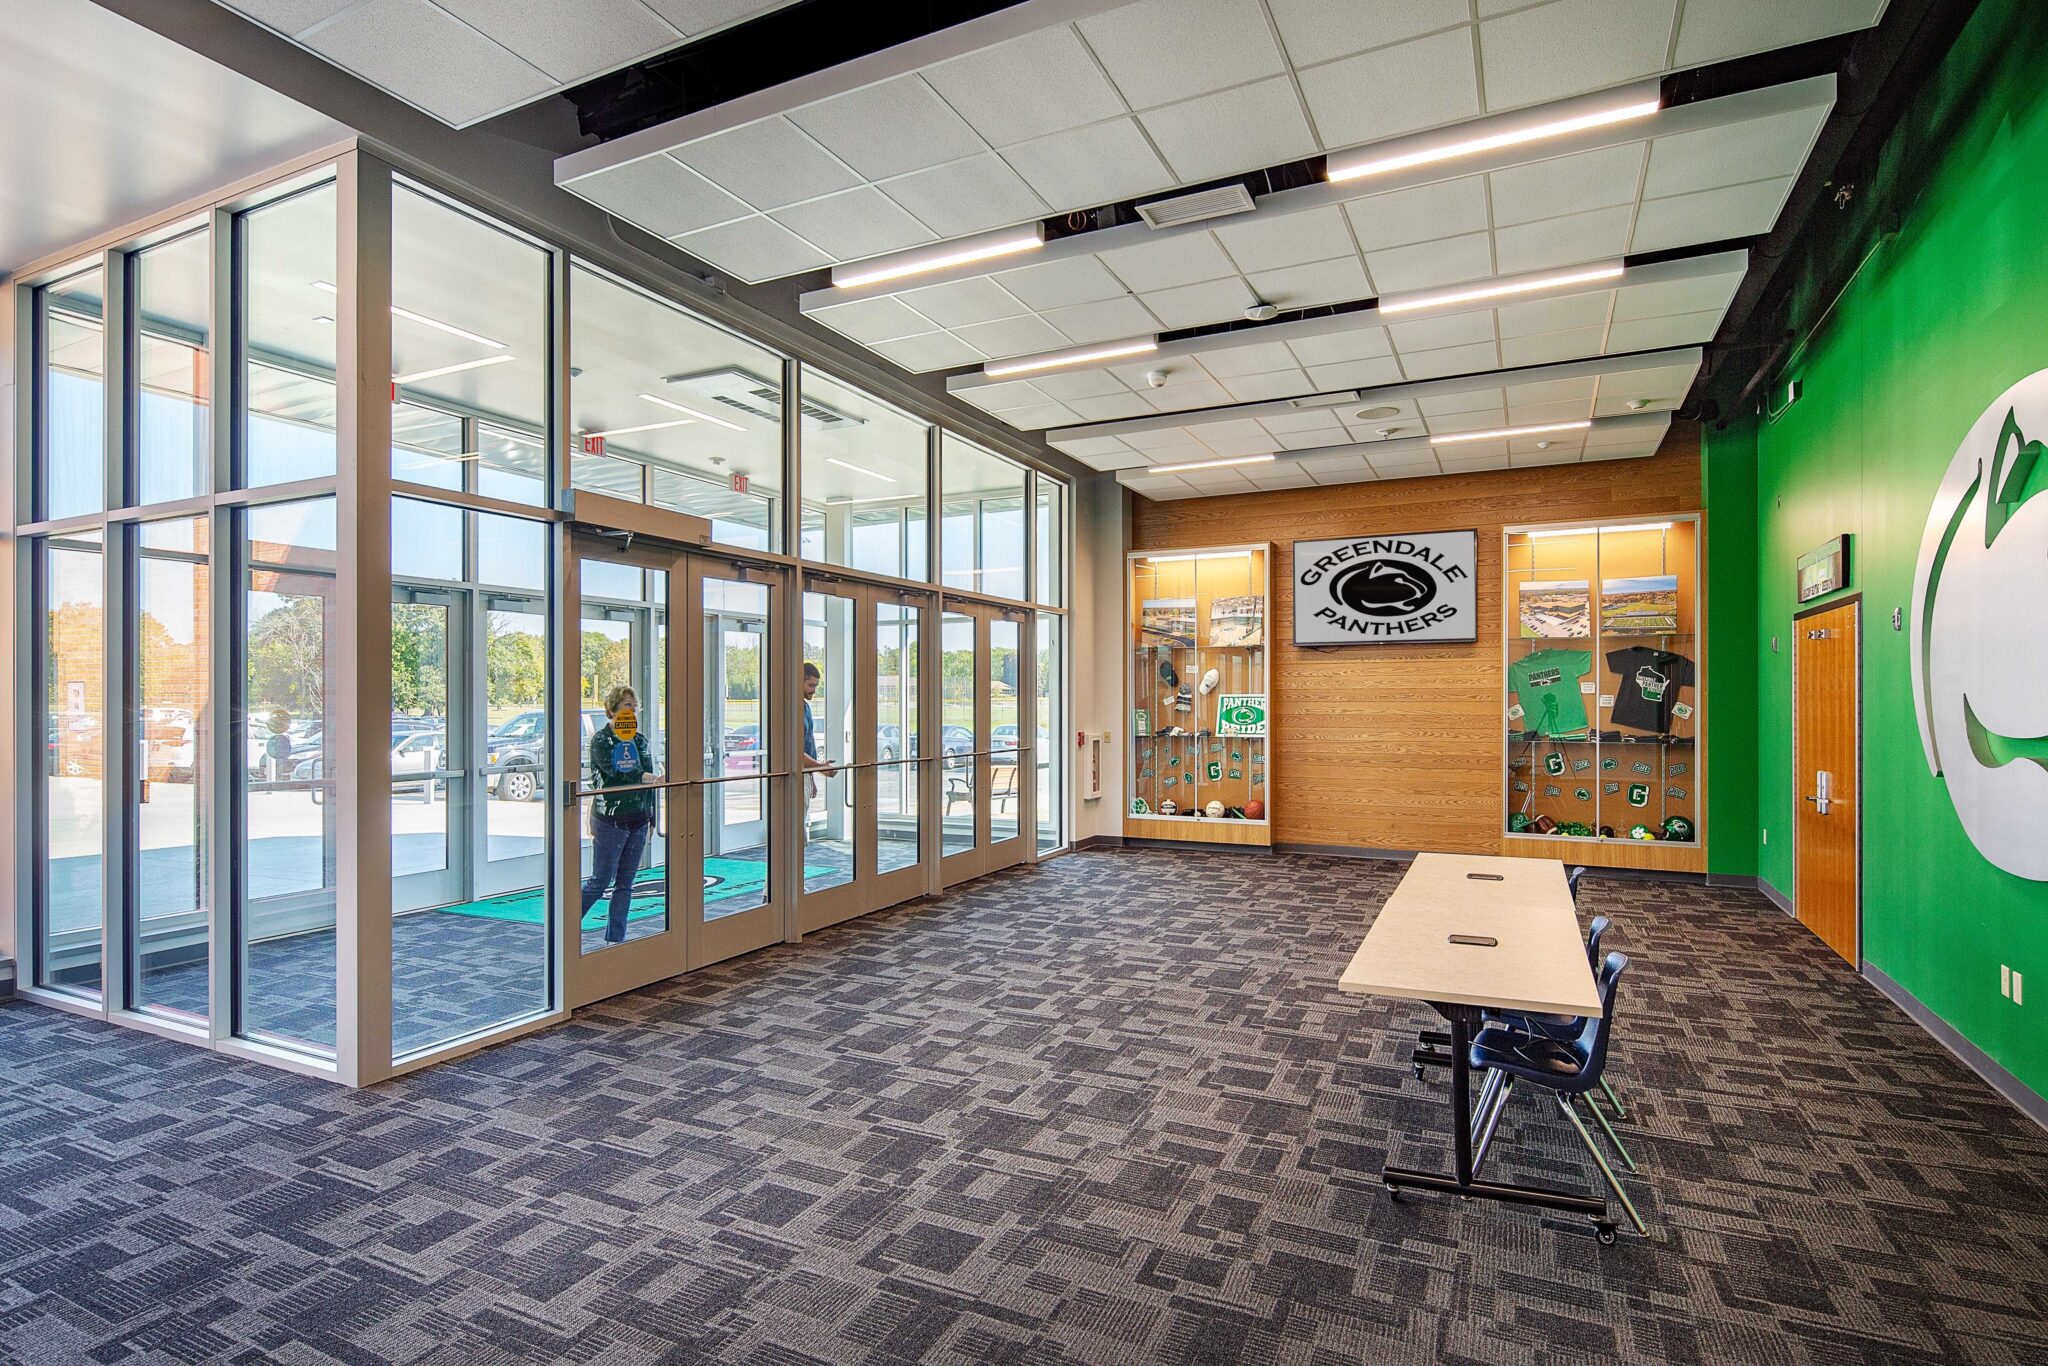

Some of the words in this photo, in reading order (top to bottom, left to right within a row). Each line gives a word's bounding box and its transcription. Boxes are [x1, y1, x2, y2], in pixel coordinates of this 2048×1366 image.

[585, 433, 603, 455] EXIT
[734, 474, 748, 494] EXIT
[1300, 539, 1468, 586] GREENDALE
[1313, 603, 1458, 636] PANTHERS
[1528, 668, 1560, 681] PANTHERS
[1206, 761, 1222, 781] G
[1544, 752, 1566, 776] G
[1627, 783, 1650, 808] G
